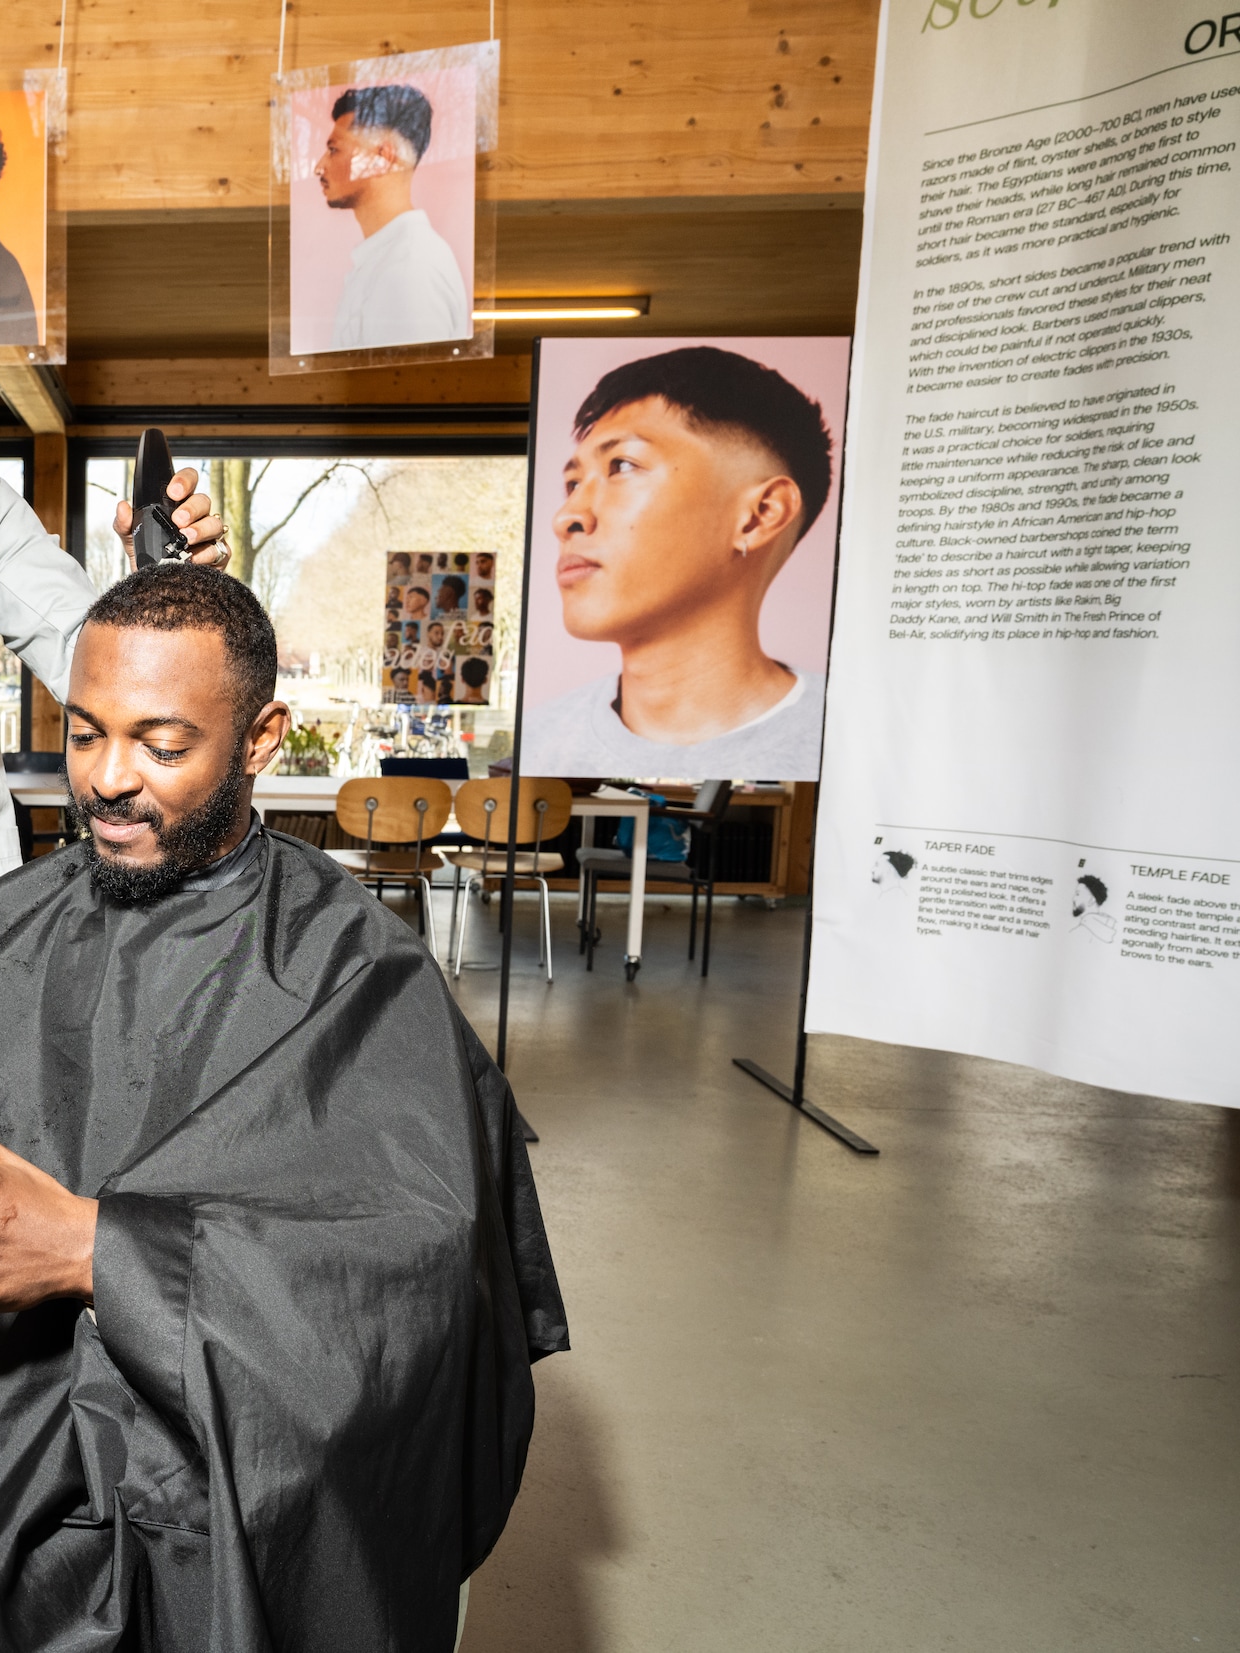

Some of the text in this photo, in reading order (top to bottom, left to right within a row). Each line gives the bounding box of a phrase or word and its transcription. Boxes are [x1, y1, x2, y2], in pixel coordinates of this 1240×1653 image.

[925, 841, 996, 856] TAPER FADE
[1130, 864, 1231, 886] TEMPLE FADE
